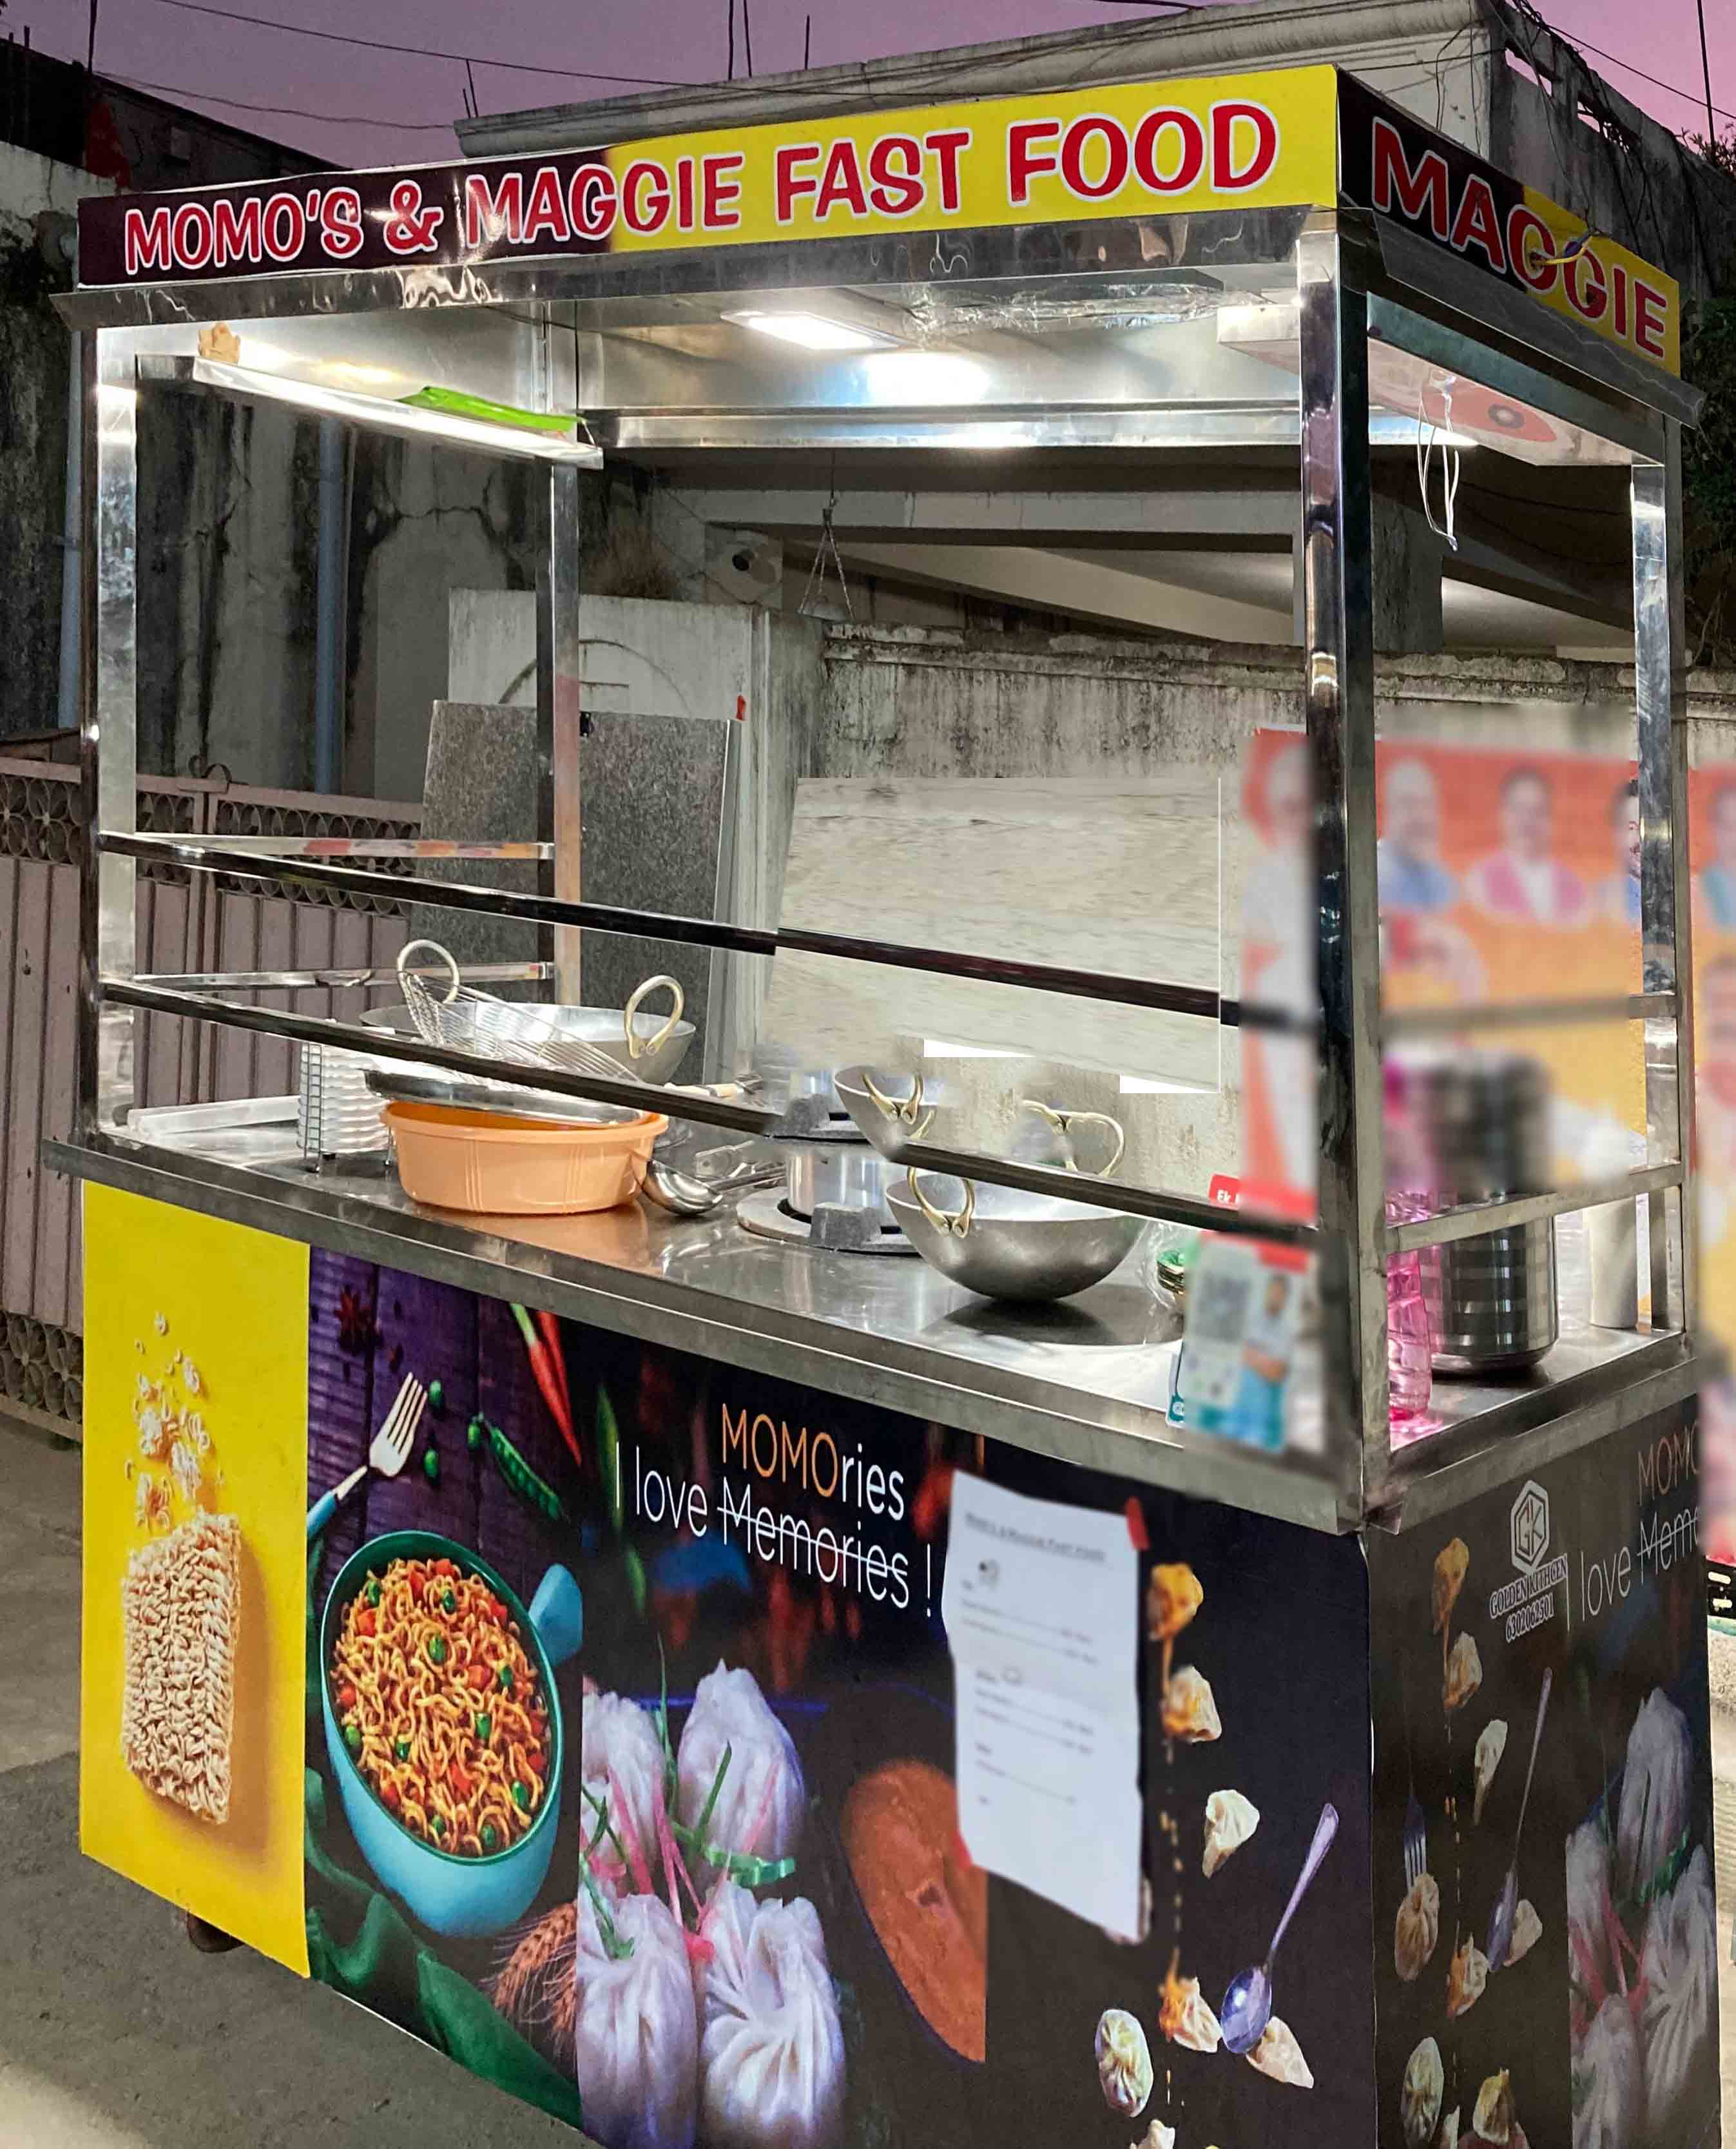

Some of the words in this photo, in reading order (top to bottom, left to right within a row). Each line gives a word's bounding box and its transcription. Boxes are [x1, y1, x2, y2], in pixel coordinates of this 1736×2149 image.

[124, 186, 364, 275] MOMO'S
[383, 179, 443, 253] &
[464, 151, 745, 249] MAGGIE
[773, 128, 972, 223] FAST
[1005, 99, 1280, 206] FOOD
[1372, 116, 1668, 360] MAGGIE
[635, 1446, 708, 1537] love
[717, 1477, 909, 1608] Memories
[722, 1403, 904, 1521] MOMOries
[1490, 1577, 1527, 1619] GOLDEN
[1580, 1546, 1631, 1622] love
